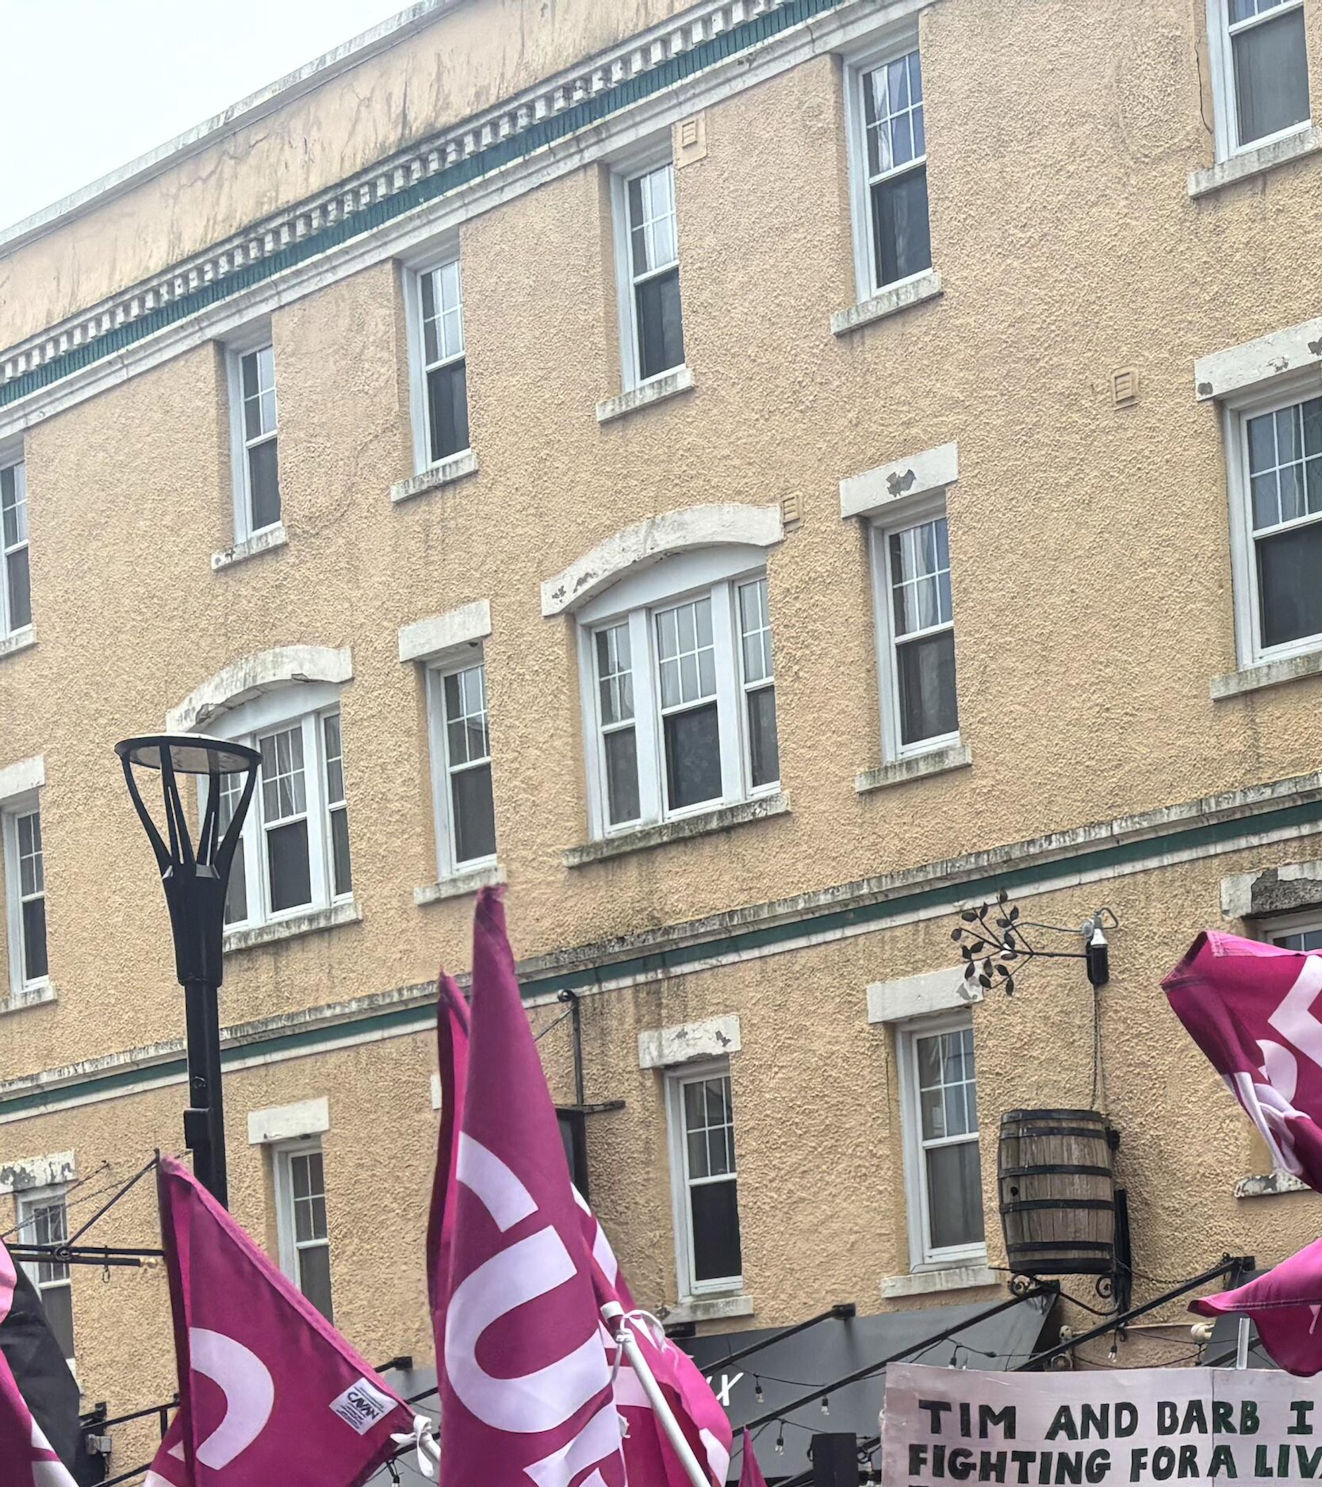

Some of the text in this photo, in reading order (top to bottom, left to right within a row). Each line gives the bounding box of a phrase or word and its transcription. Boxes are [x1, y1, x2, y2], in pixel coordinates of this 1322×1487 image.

[918, 1399, 1016, 1439] TIM
[1045, 1402, 1139, 1440] AND
[1157, 1399, 1260, 1435] BARB
[1287, 1401, 1314, 1435] I
[908, 1444, 1111, 1485] FIGHTING
[1130, 1445, 1199, 1483] FOR
[1207, 1445, 1237, 1478] A
